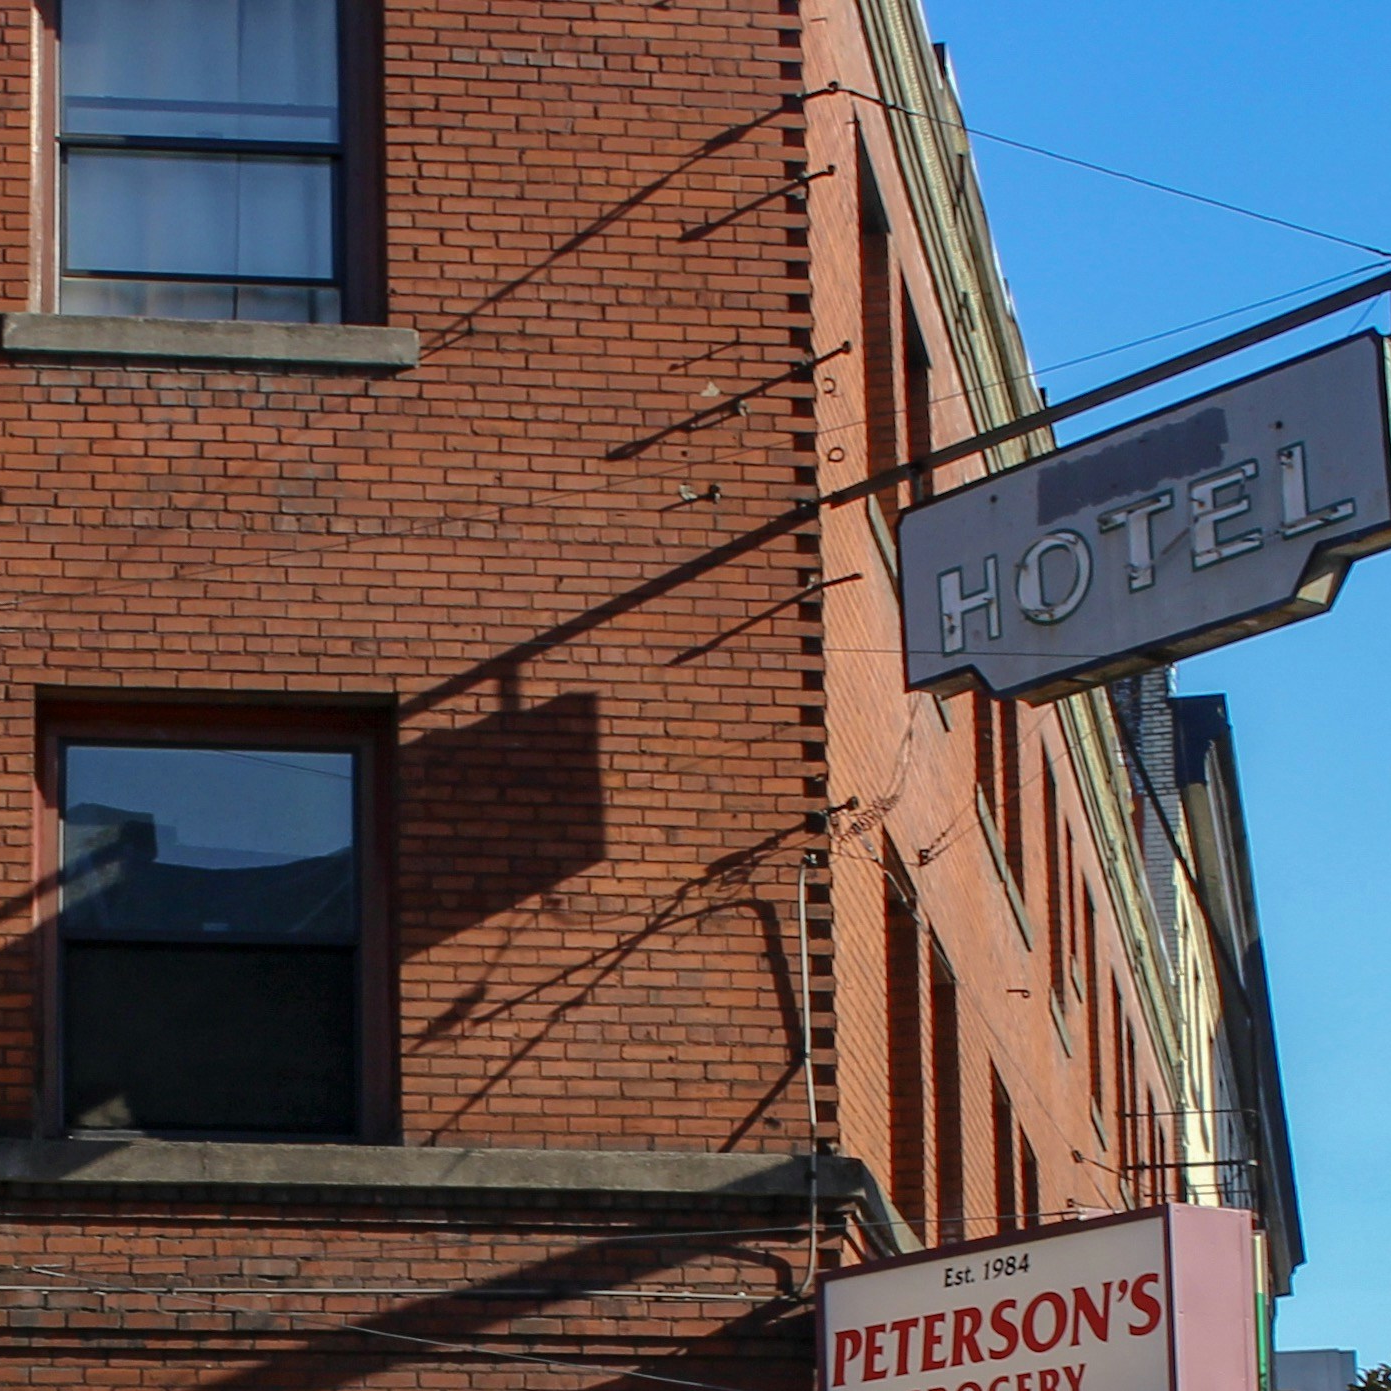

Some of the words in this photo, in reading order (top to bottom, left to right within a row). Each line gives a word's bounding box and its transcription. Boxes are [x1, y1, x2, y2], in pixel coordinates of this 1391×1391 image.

[937, 441, 1357, 656] HOTEL
[943, 1267, 975, 1288] Est.
[982, 1253, 1031, 1280] 1984
[832, 1273, 1162, 1388] PETERSON'S
